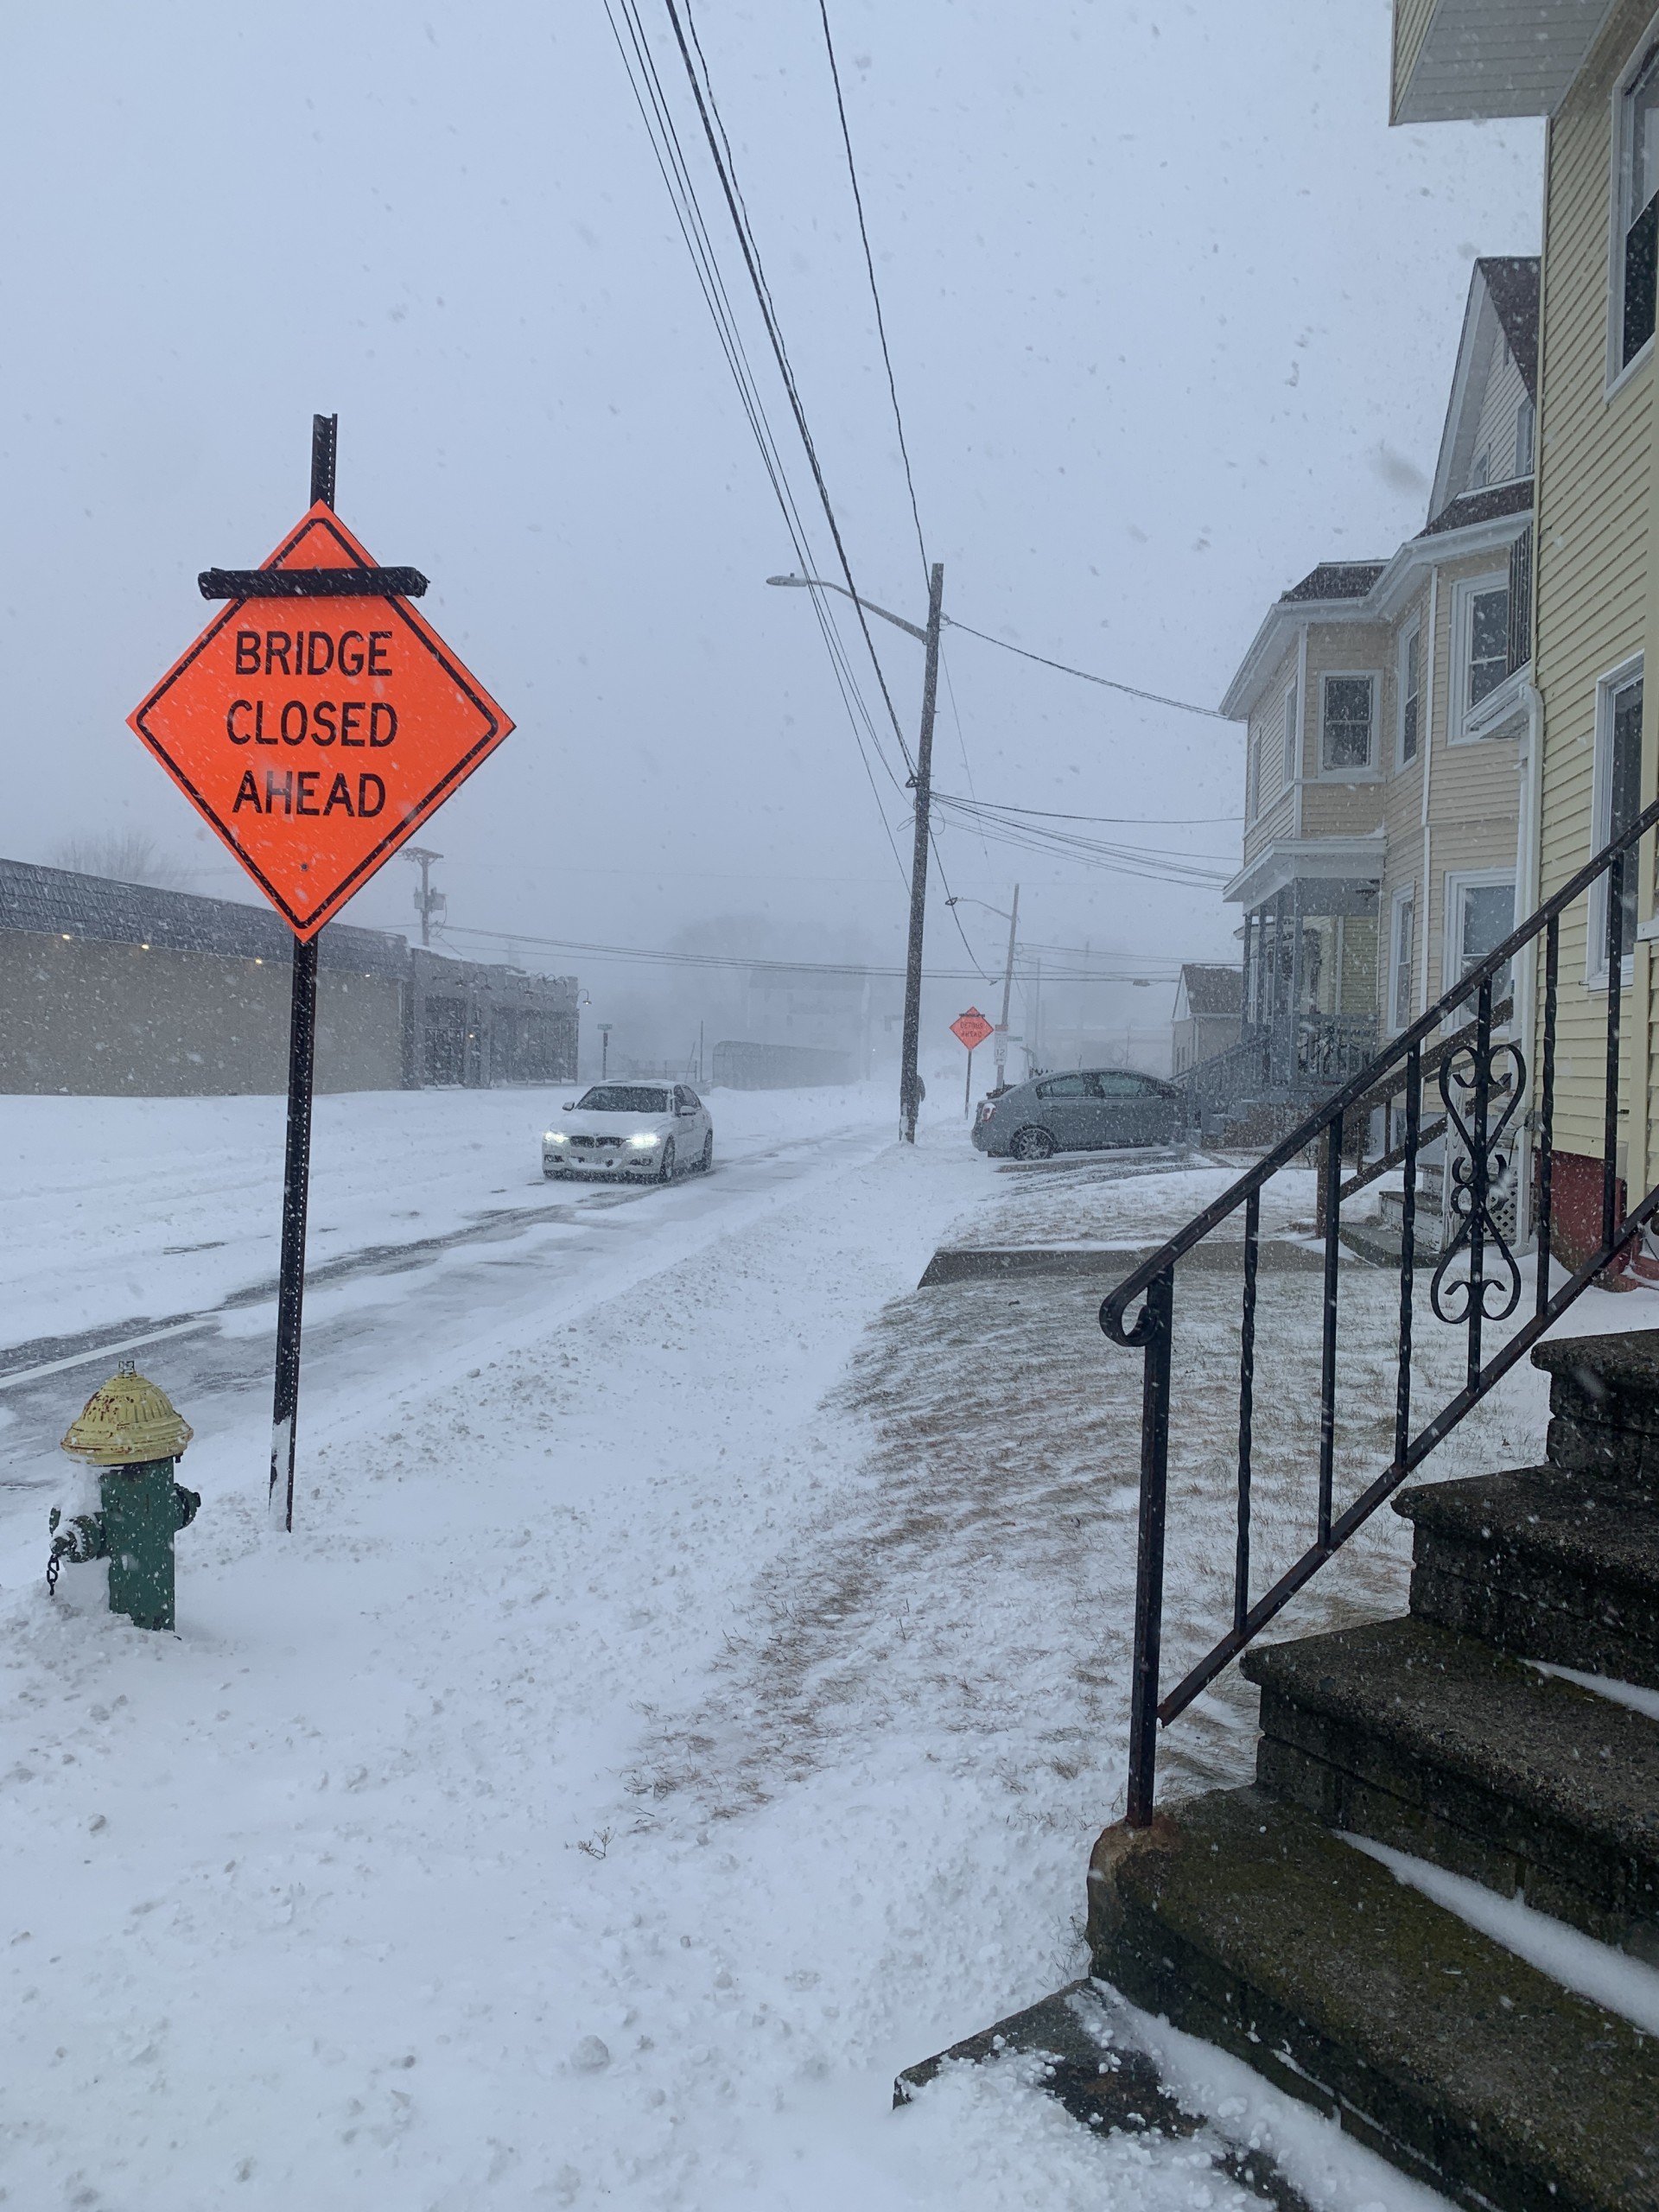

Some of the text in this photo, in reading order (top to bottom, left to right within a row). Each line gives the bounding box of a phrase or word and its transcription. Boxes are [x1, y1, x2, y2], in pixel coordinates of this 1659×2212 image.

[236, 632, 392, 677] BRIDGE
[227, 700, 397, 747] CLOSED
[232, 771, 385, 817] AHEAD
